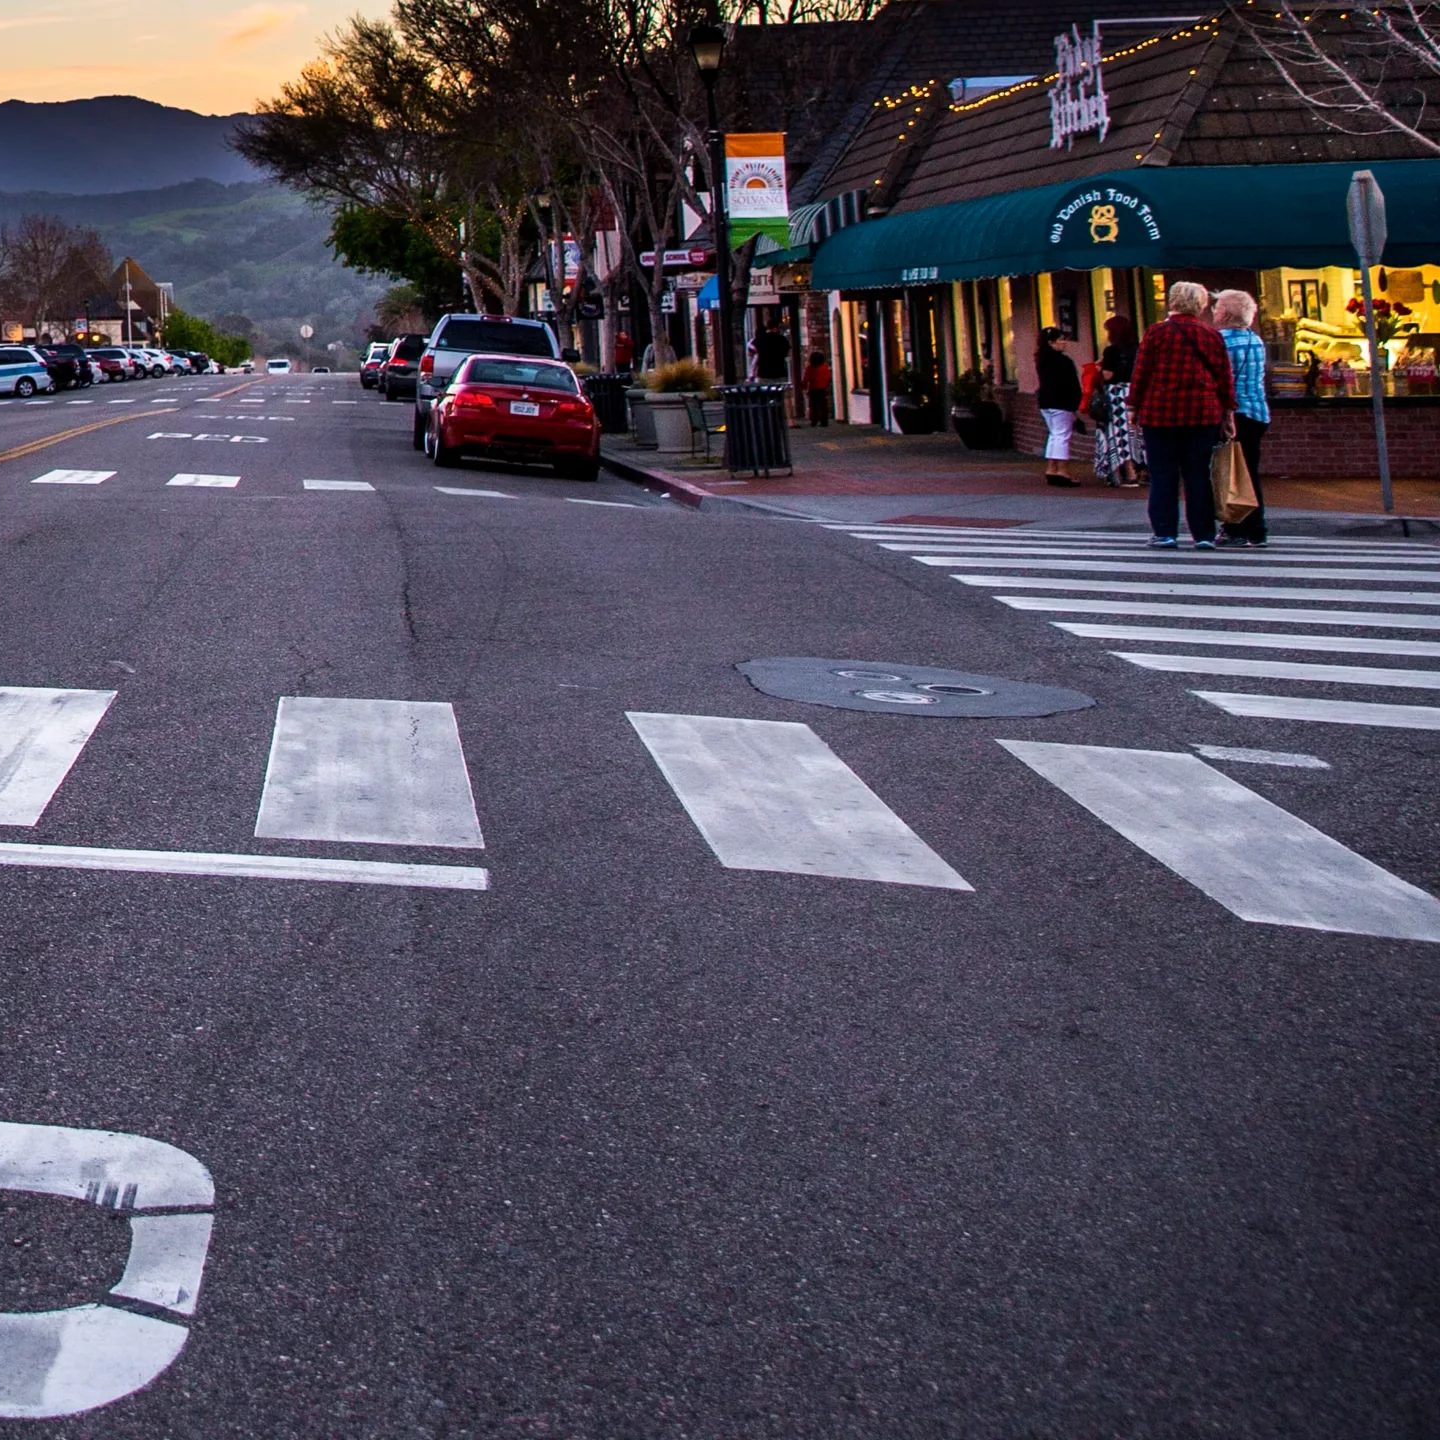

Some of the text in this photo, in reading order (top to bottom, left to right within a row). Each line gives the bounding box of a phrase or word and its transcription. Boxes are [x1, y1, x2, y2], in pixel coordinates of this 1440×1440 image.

[731, 195, 783, 205] SOLVANG
[1050, 188, 1161, 243] Old Danish Food Farm
[146, 432, 269, 443] PED
